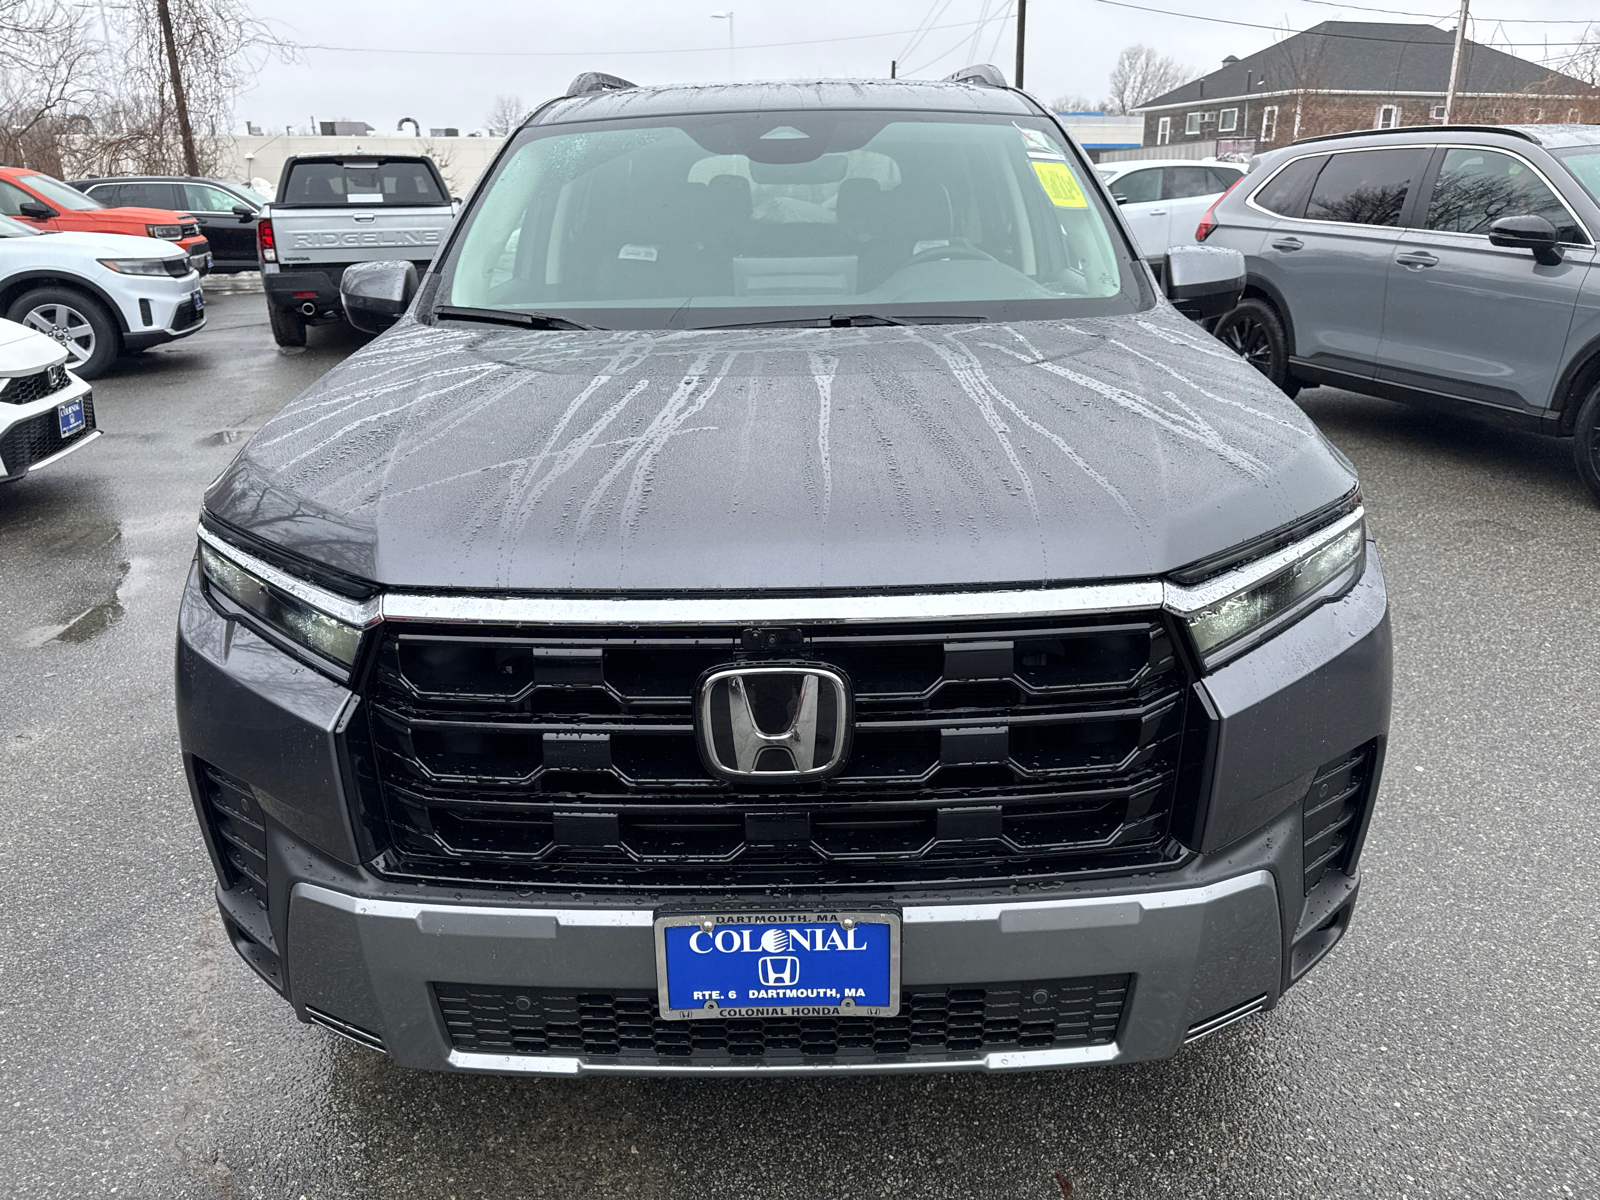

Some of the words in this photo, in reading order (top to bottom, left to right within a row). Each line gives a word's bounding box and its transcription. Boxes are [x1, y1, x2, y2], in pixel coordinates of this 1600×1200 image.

[293, 230, 440, 248] RIDGELINE
[817, 914, 838, 922] MA
[689, 928, 867, 954] COLONIAL
[693, 990, 724, 1000] RTE.
[728, 990, 737, 999] 6
[748, 988, 841, 999] DARTMOUTH,
[844, 988, 866, 998] MA
[719, 1007, 787, 1018] COLONIAL
[791, 1007, 841, 1016] HONDA
